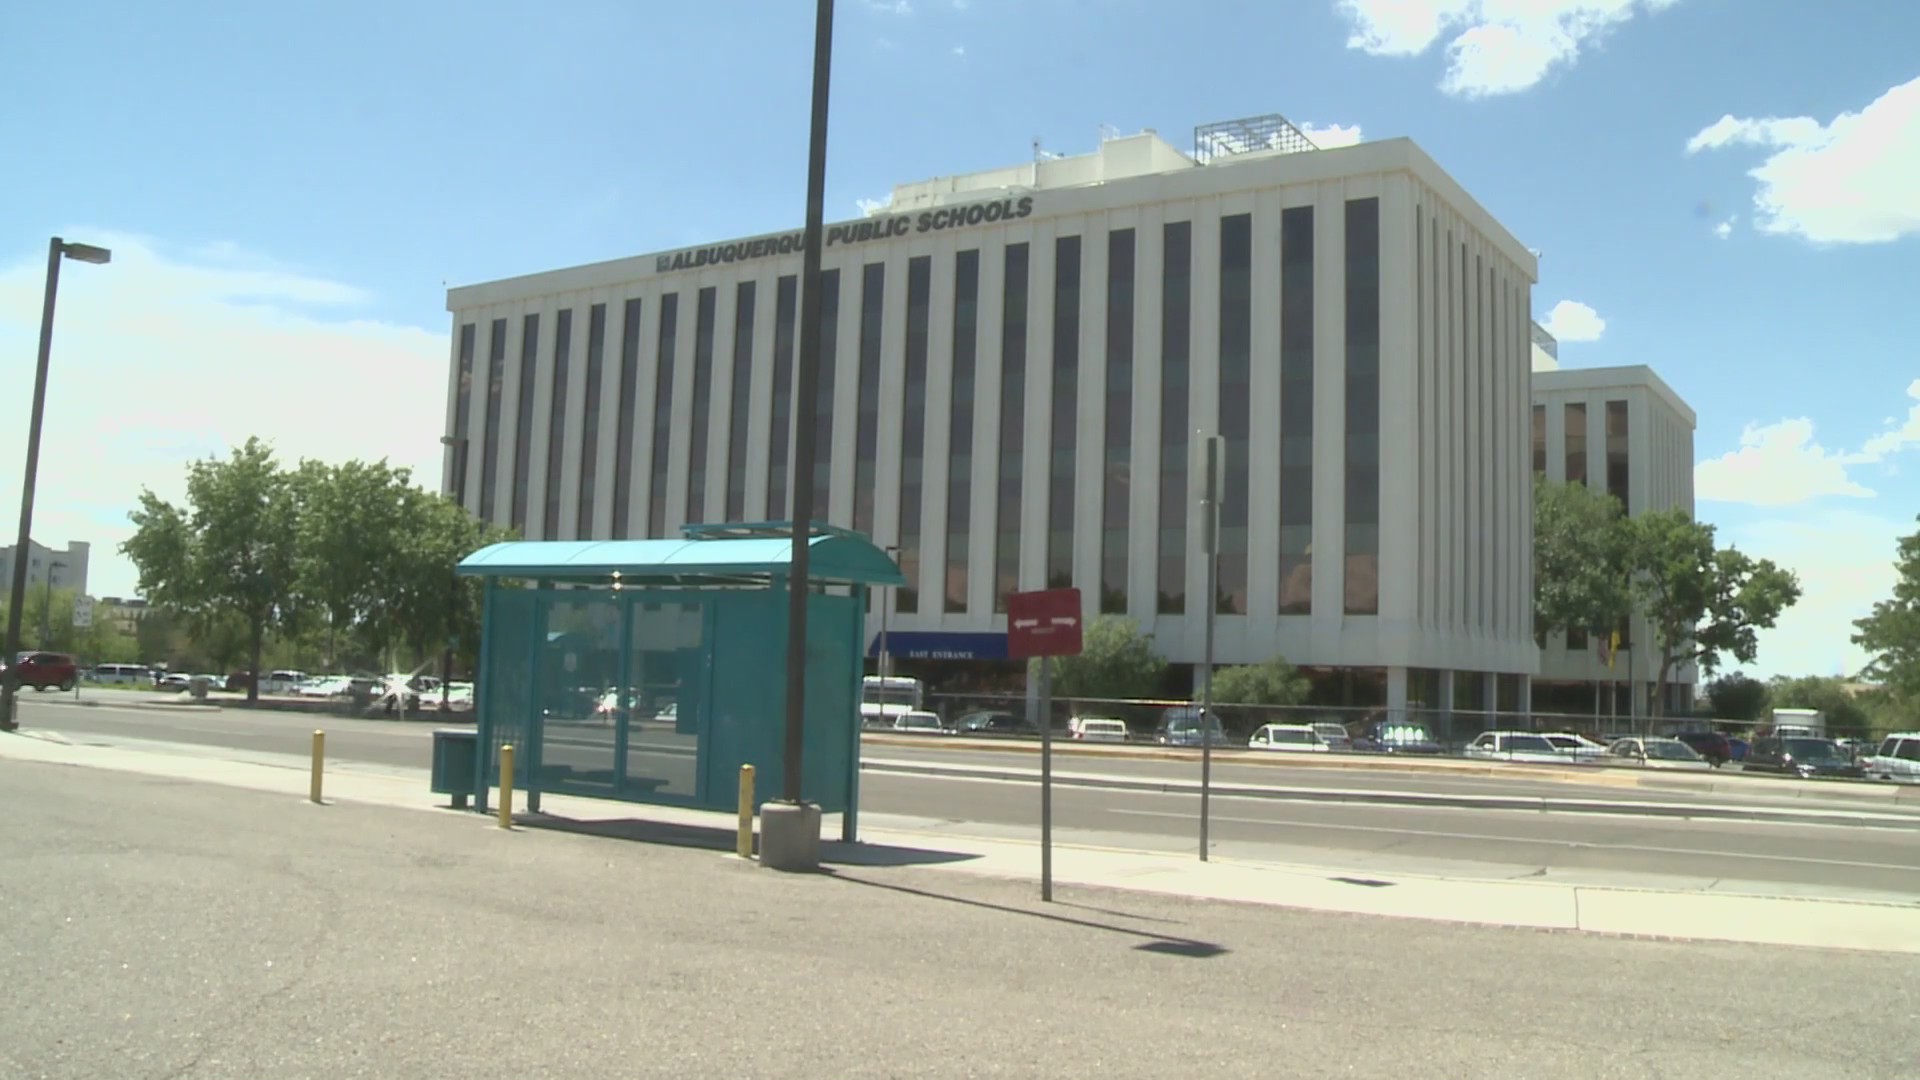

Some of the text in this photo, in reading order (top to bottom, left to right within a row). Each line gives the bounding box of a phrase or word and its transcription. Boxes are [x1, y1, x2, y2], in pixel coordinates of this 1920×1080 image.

[671, 196, 1034, 271] ALBUQUERQU PUBLIC SCHOOLS
[909, 650, 973, 660] EAST ENTRANCE
